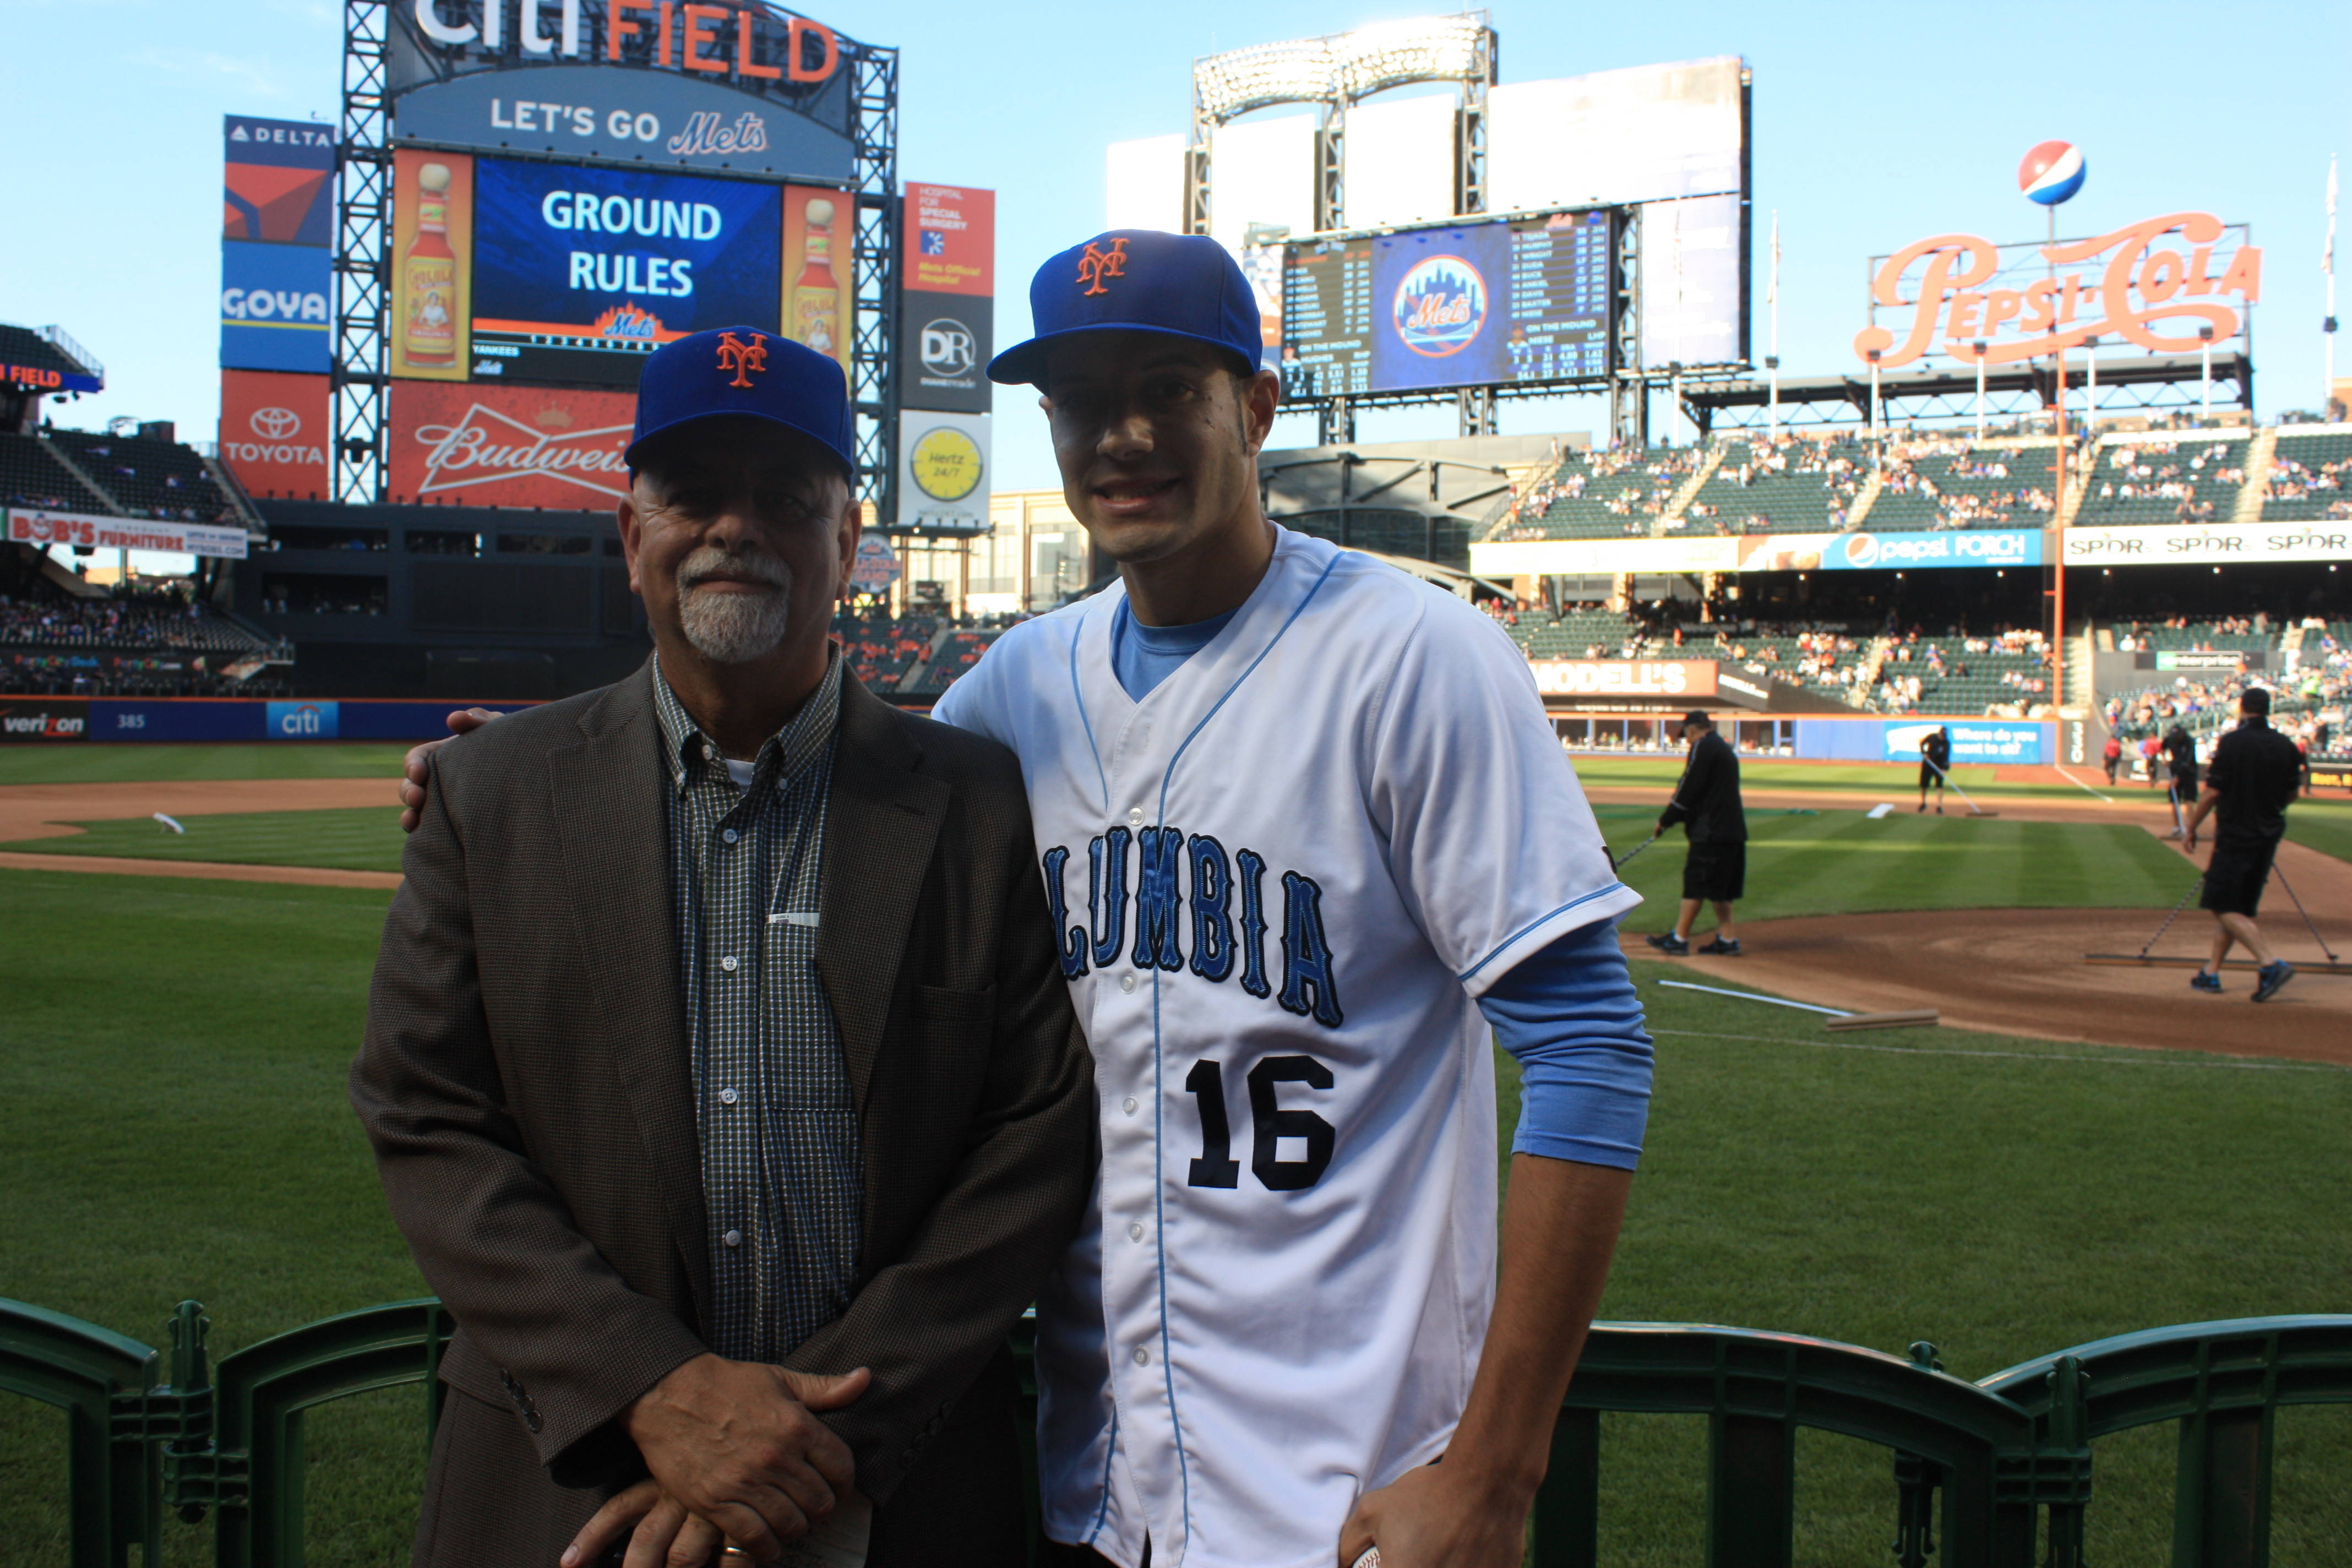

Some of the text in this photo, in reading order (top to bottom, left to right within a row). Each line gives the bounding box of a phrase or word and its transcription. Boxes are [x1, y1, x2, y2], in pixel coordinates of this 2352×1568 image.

[607, 0, 839, 83] FIELD
[254, 126, 330, 148] DELTA
[490, 99, 769, 155] LET'S GO Mets
[919, 187, 964, 200] HOSPITAL
[919, 196, 939, 206] FOR
[542, 190, 722, 241] GROUND
[919, 206, 962, 220] SPECIAL
[919, 217, 968, 231] SURGERY
[1522, 250, 1553, 260] WRIGHT
[569, 251, 693, 298] RULES
[222, 288, 328, 321] GOYA
[1408, 293, 1471, 330] Mets
[603, 312, 655, 339] Mets
[1525, 319, 1597, 334] ON THE MOUND
[472, 345, 520, 357] YANKEES
[546, 335, 553, 345] 2
[562, 337, 568, 346] 3
[576, 337, 584, 347] 4
[592, 339, 599, 348] 5
[607, 340, 614, 349] 6
[622, 340, 629, 349] 7
[638, 341, 644, 351] 8
[921, 329, 975, 367] DR
[1313, 343, 1329, 351] THE
[1329, 340, 1361, 350] MOUND
[1528, 335, 1554, 345] NIESE
[1300, 353, 1333, 364] HUGHES
[10, 365, 62, 388] FIELD
[225, 442, 325, 465] TOYOTA
[929, 452, 965, 465] Hertz
[933, 467, 960, 477] 24/7
[13, 514, 95, 546] BOB'S
[99, 529, 184, 551] FURNITURE
[1880, 534, 2025, 562] pepsi PORCH
[1528, 662, 1686, 693] MODELL'S
[3, 713, 85, 736] verizon
[117, 715, 146, 728] 385
[281, 709, 319, 734] citi
[1994, 728, 2012, 741] do
[1185, 1055, 1336, 1191] 16
